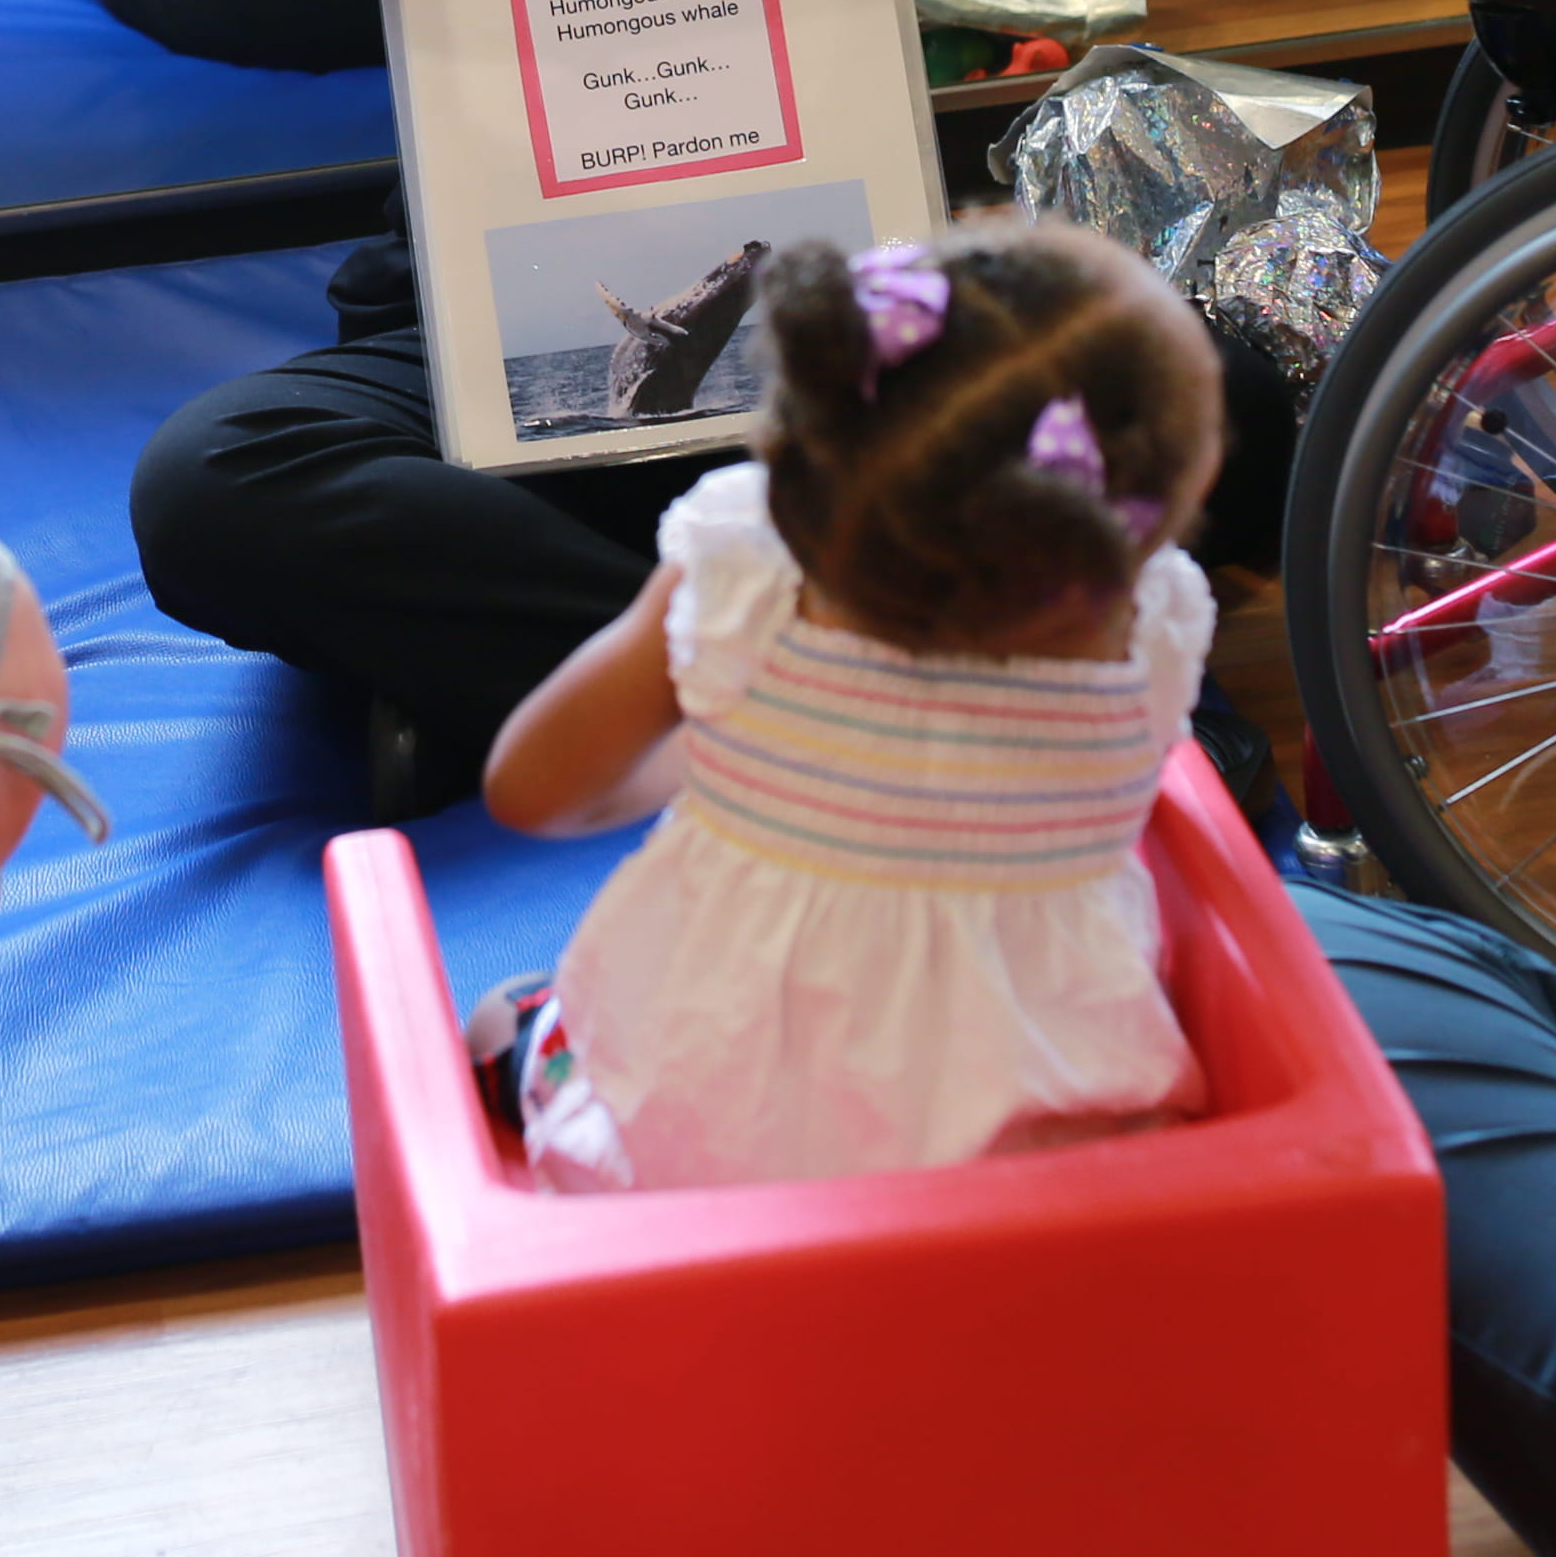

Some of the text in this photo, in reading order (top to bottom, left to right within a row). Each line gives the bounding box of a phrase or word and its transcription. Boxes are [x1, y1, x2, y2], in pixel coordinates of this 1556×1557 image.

[557, 0, 739, 41] Humongous whale
[624, 88, 698, 110] Gunk...
[581, 131, 760, 170] BURP! Pardon me
